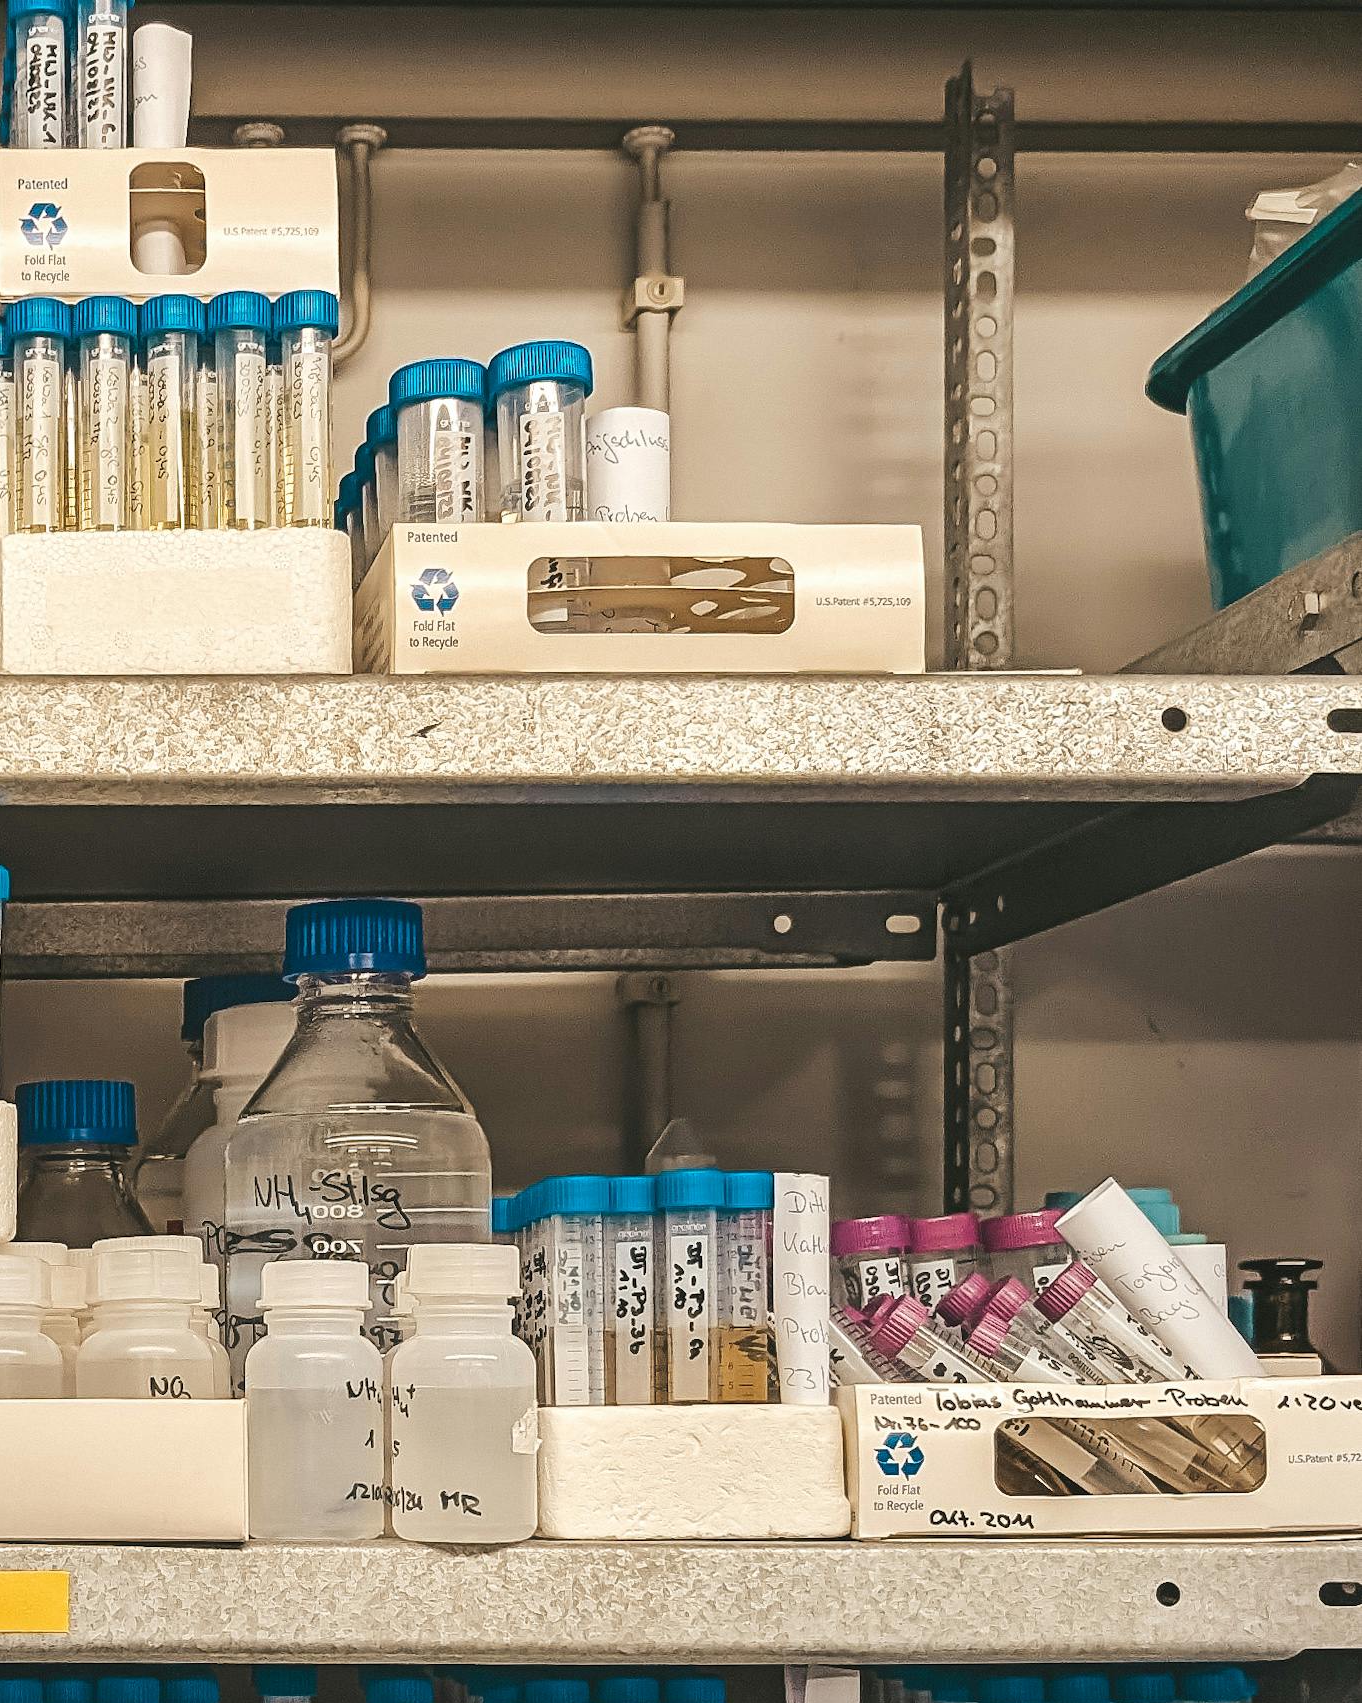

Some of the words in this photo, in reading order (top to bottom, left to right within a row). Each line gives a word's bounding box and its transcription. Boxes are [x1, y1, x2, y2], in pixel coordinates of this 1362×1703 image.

[18, 178, 68, 190] Patented
[25, 254, 46, 266] Fold
[48, 254, 67, 266] Flat
[21, 270, 32, 282] to
[34, 270, 70, 283] Recycle
[407, 531, 458, 543] Patented
[862, 597, 912, 609] #5,725,109
[413, 620, 435, 632] Fold
[437, 620, 456, 632] Flat
[409, 636, 420, 648] to
[422, 636, 459, 650] Recycle
[869, 1393, 922, 1406] Patented
[877, 1484, 898, 1496] Fold
[901, 1484, 921, 1496] Flat
[874, 1500, 885, 1512] to
[886, 1499, 924, 1514] Recycle
